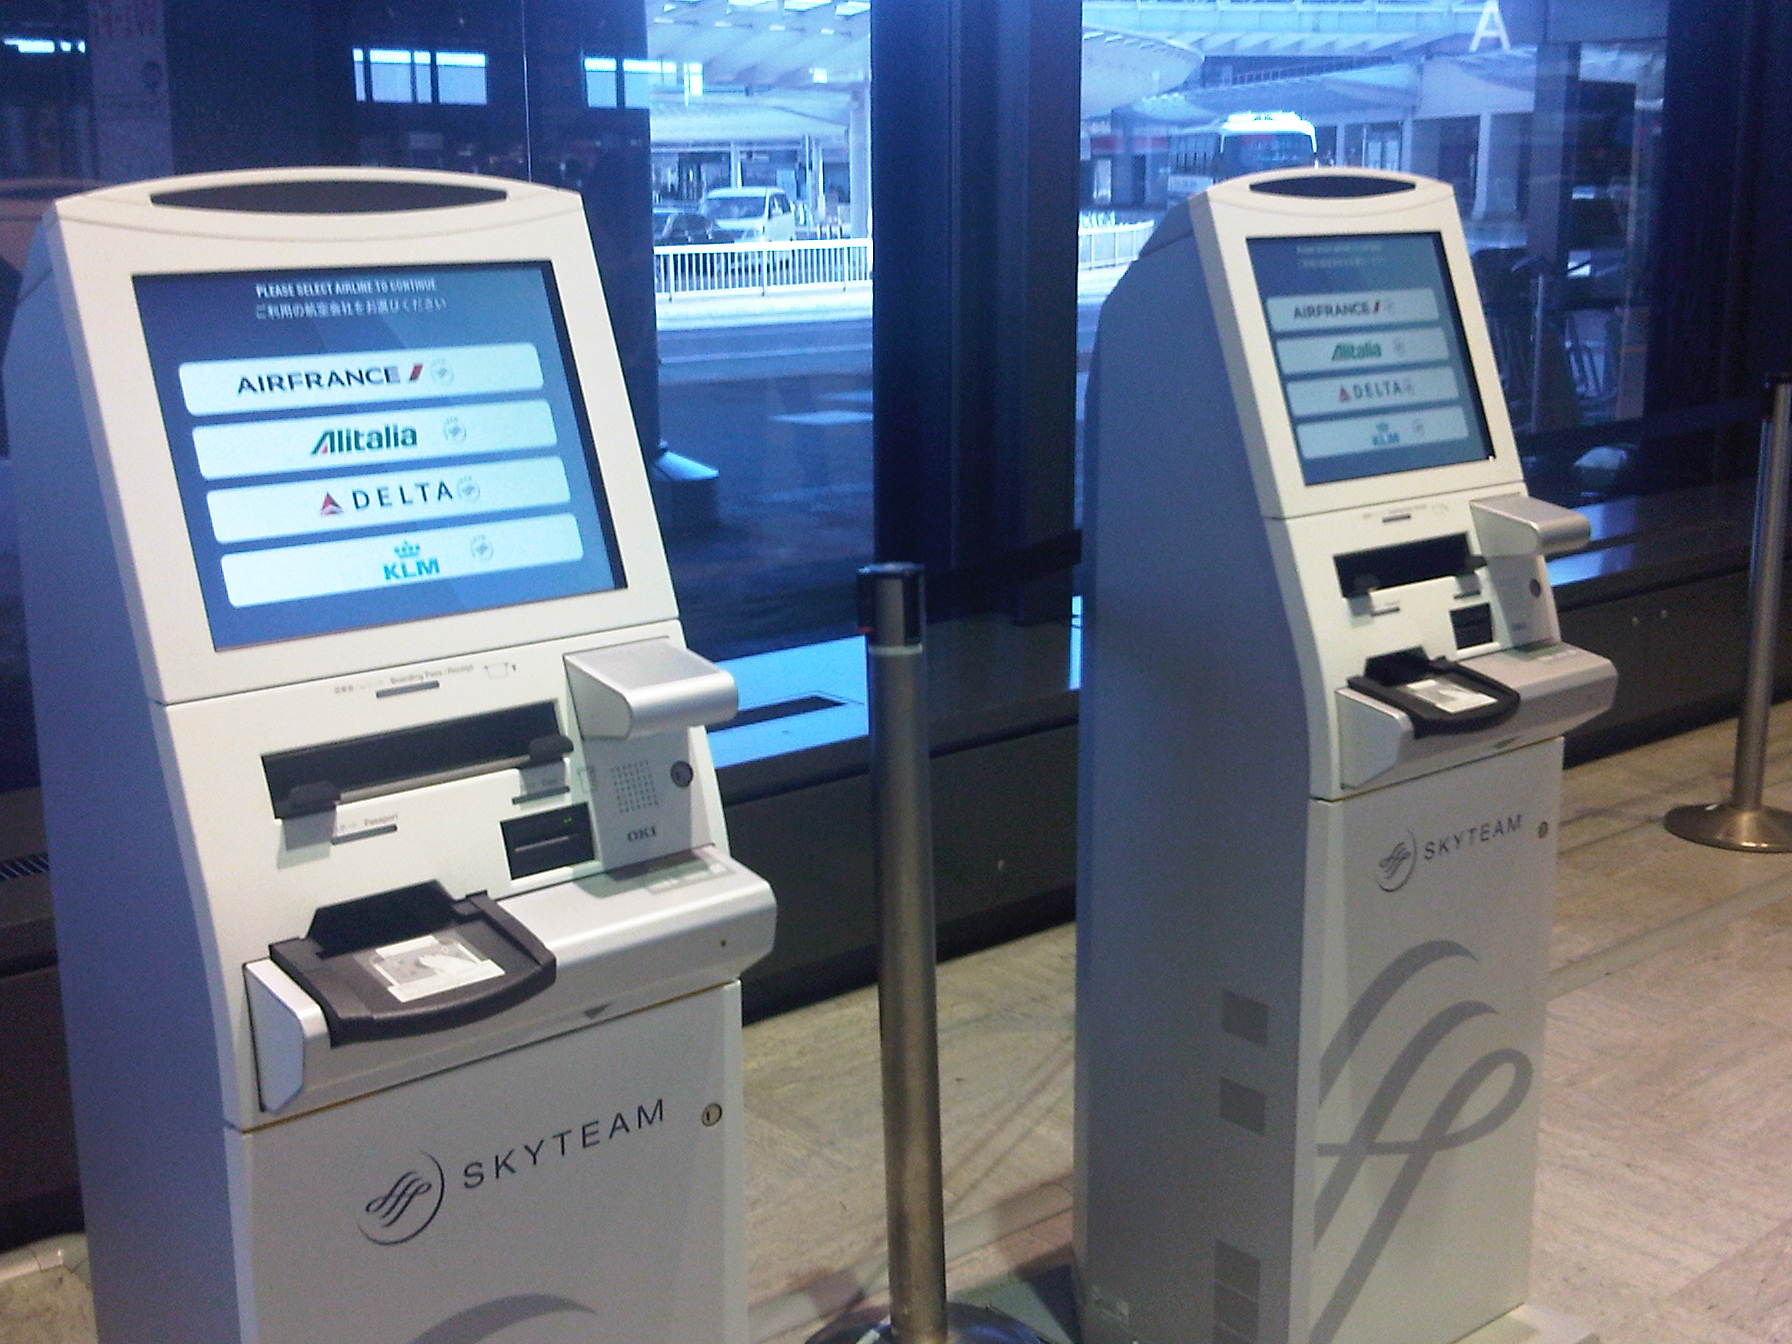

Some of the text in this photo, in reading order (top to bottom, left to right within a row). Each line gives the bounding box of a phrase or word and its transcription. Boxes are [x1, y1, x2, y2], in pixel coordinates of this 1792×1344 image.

[1468, 0, 1511, 54] A
[256, 278, 436, 298] PLEASE SELECT AIRLINE TO CONTINUE
[1293, 303, 1369, 319] AIRFRANCE
[1331, 340, 1382, 361] Alitalia
[237, 366, 400, 394] AIRFRANCE
[1353, 381, 1401, 399] DELTA
[311, 424, 417, 456] Alitalia
[352, 480, 453, 510] DELTA
[383, 559, 440, 581] KLM
[627, 826, 656, 842] OKI
[1424, 814, 1522, 860] SKYTEAM
[463, 1099, 663, 1189] SKYTEAM
